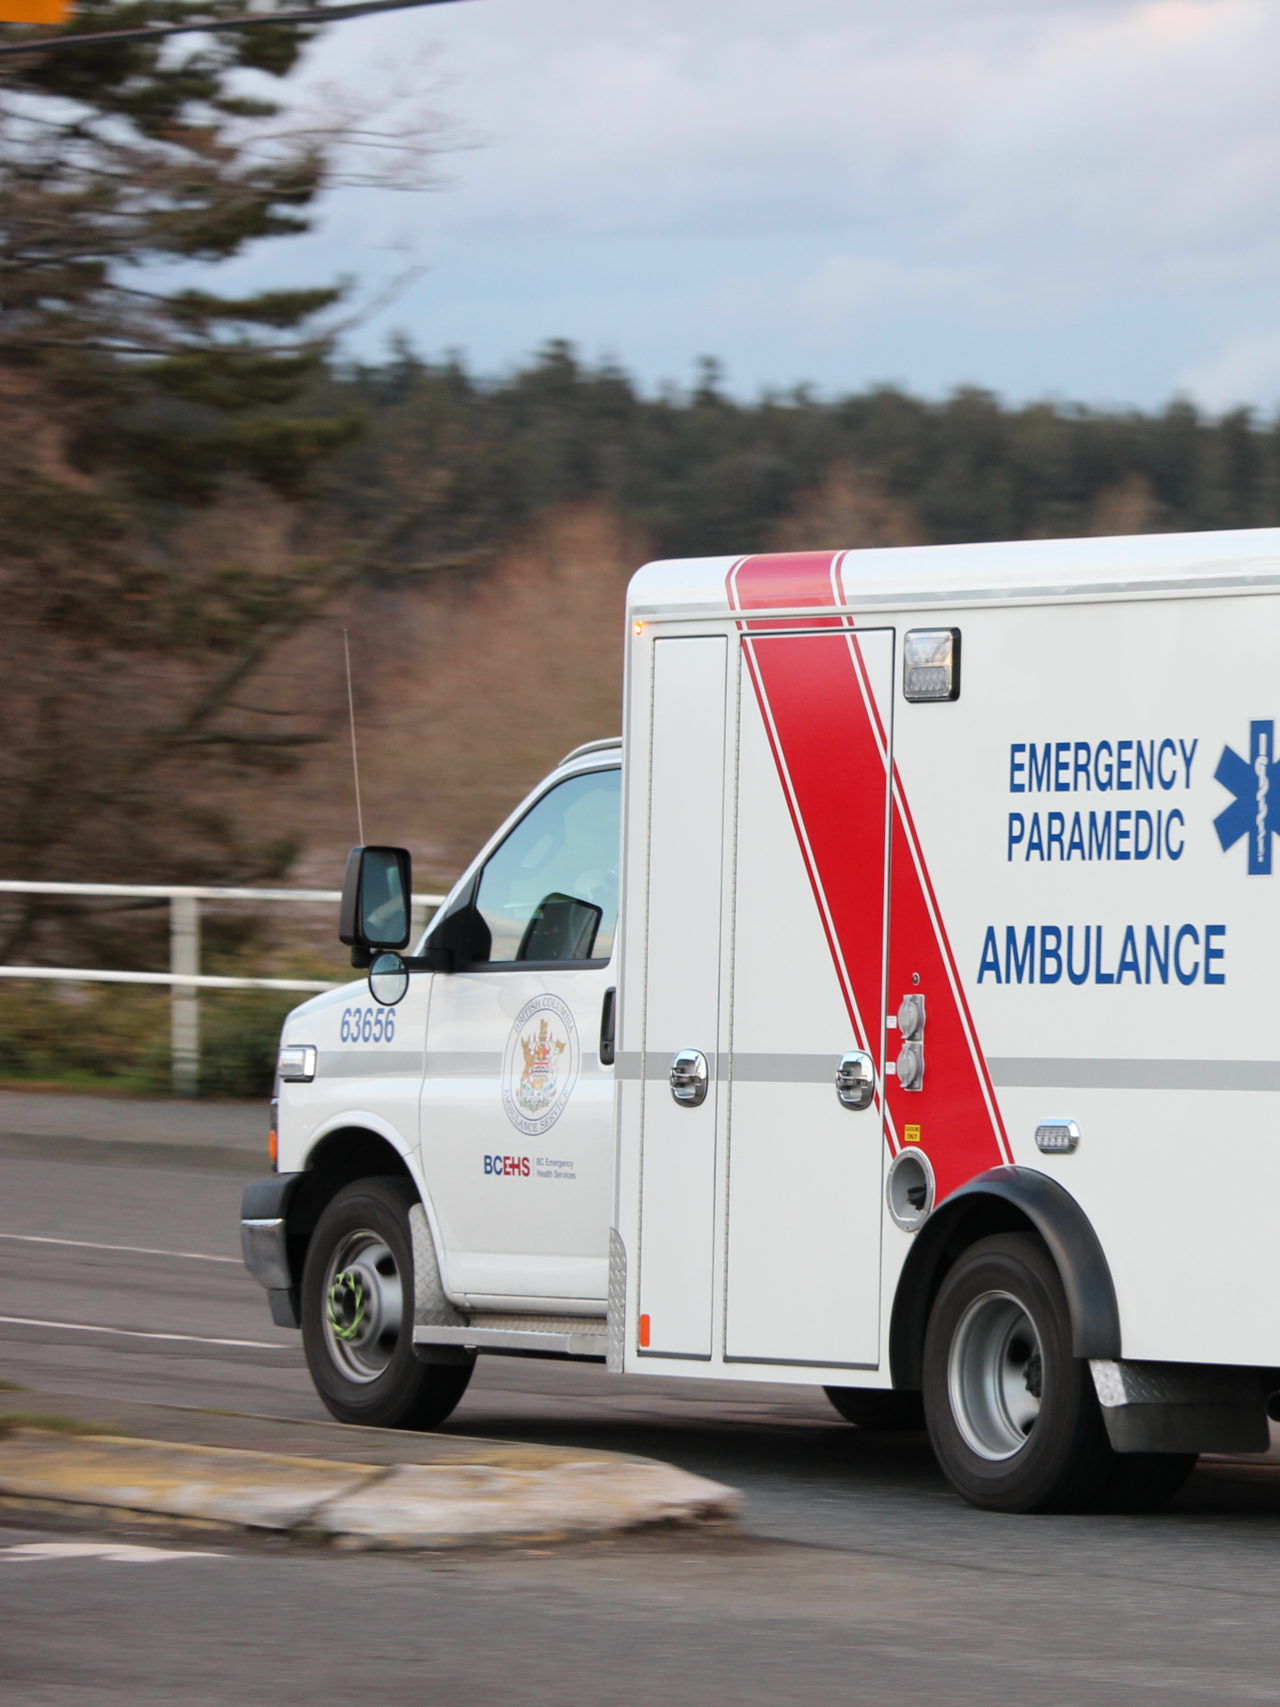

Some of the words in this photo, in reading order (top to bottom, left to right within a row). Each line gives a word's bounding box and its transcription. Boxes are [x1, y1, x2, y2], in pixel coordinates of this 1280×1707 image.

[1009, 738, 1198, 793] EMERGENCY
[1008, 808, 1185, 862] PARAMEDIC
[976, 923, 1226, 986] AMBULANCE
[341, 1007, 396, 1043] 63656
[514, 999, 541, 1033] BRITISH
[543, 997, 574, 1034] COLUMBIA
[484, 1155, 530, 1177] BCEHS
